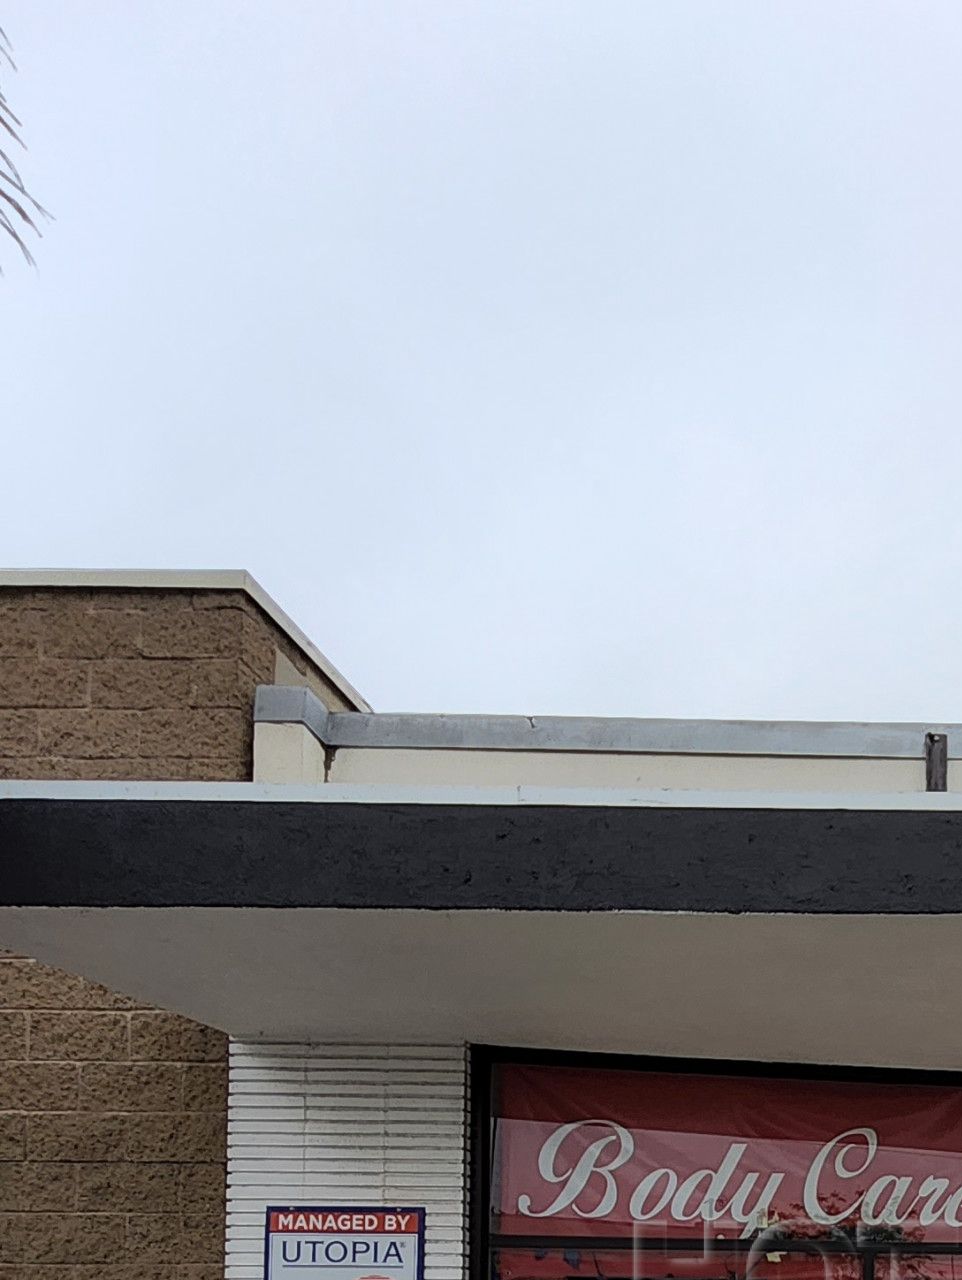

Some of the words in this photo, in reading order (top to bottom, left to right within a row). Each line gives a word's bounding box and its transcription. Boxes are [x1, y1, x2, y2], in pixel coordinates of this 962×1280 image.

[518, 1118, 786, 1240] Body
[277, 1213, 379, 1231] MANAGED
[383, 1214, 411, 1231] BY
[281, 1239, 404, 1264] UTOPIA
